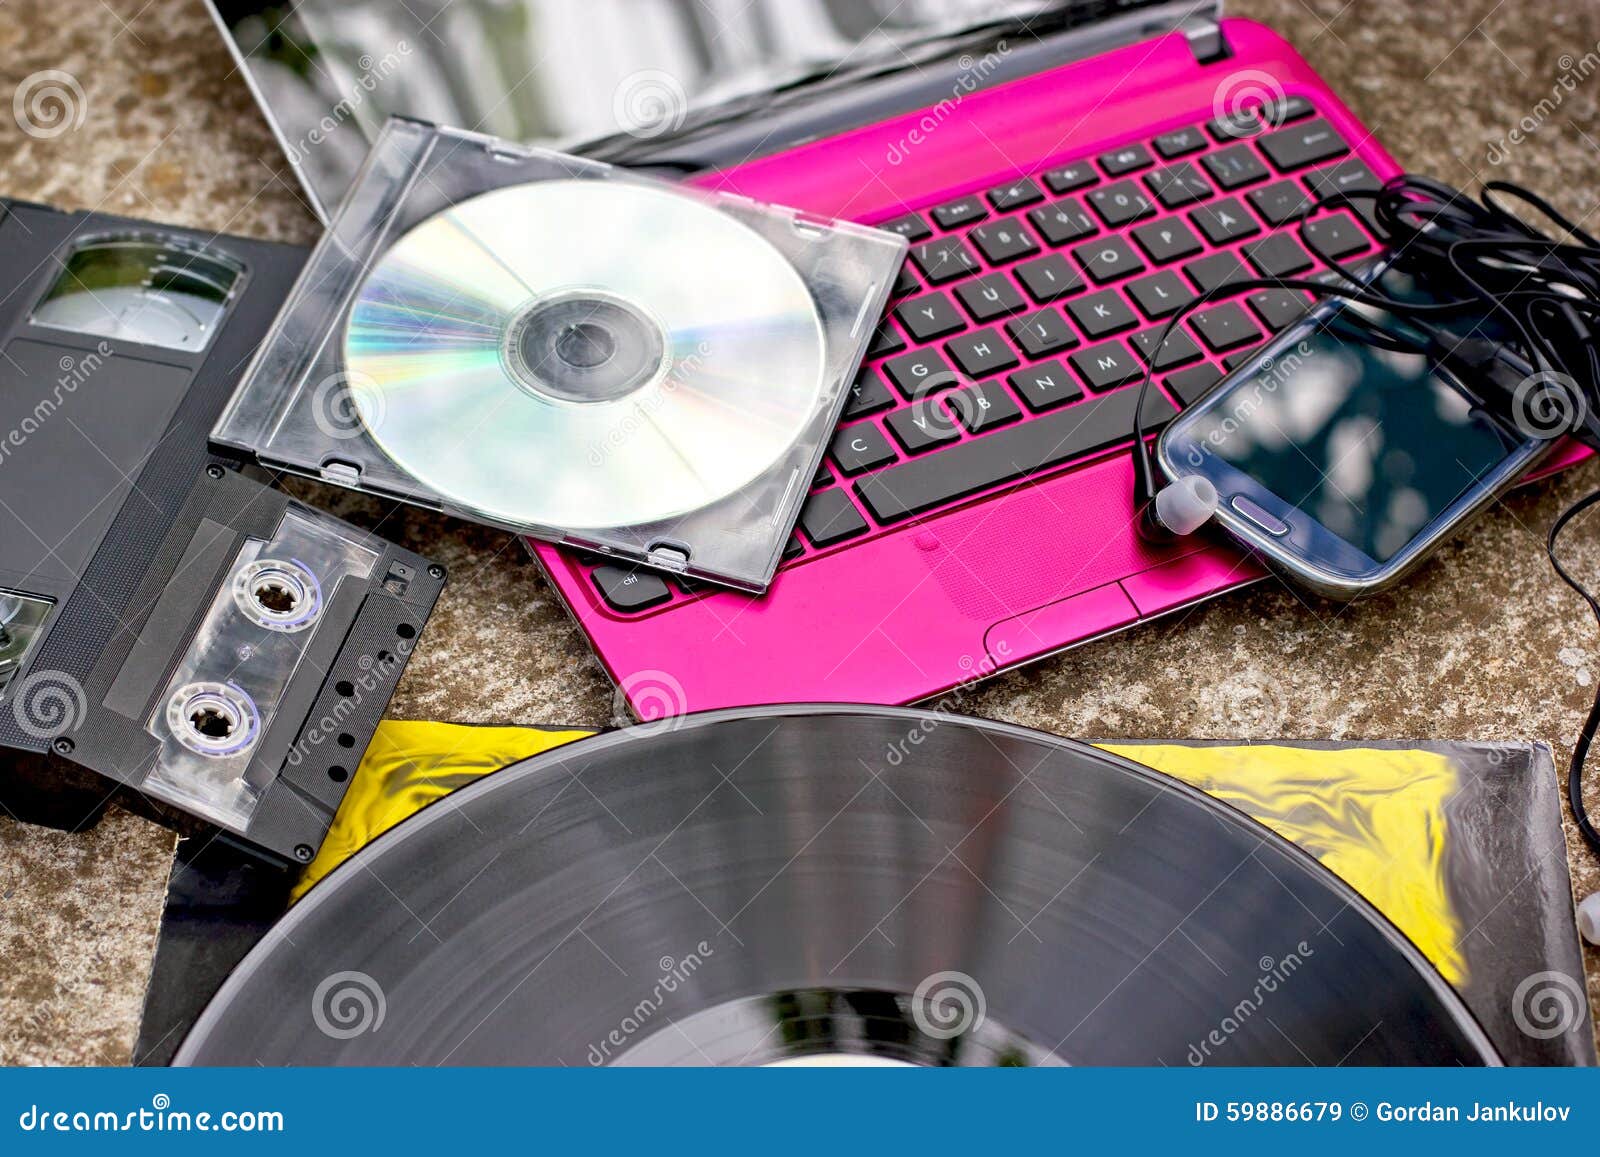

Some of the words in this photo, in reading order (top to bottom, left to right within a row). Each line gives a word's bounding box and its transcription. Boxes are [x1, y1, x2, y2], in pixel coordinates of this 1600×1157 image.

[1160, 231, 1172, 244] P
[1100, 249, 1118, 263] O
[982, 287, 999, 301] U
[1154, 286, 1168, 298] L
[921, 307, 935, 320] Y
[1093, 303, 1111, 318] K
[1037, 323, 1047, 337] J
[973, 343, 991, 357] H
[911, 363, 928, 376] G
[1097, 356, 1117, 370] M
[1035, 376, 1055, 390] N
[977, 397, 991, 410] B
[912, 417, 926, 429] V
[851, 438, 868, 452] C
[623, 574, 638, 586] ctrl
